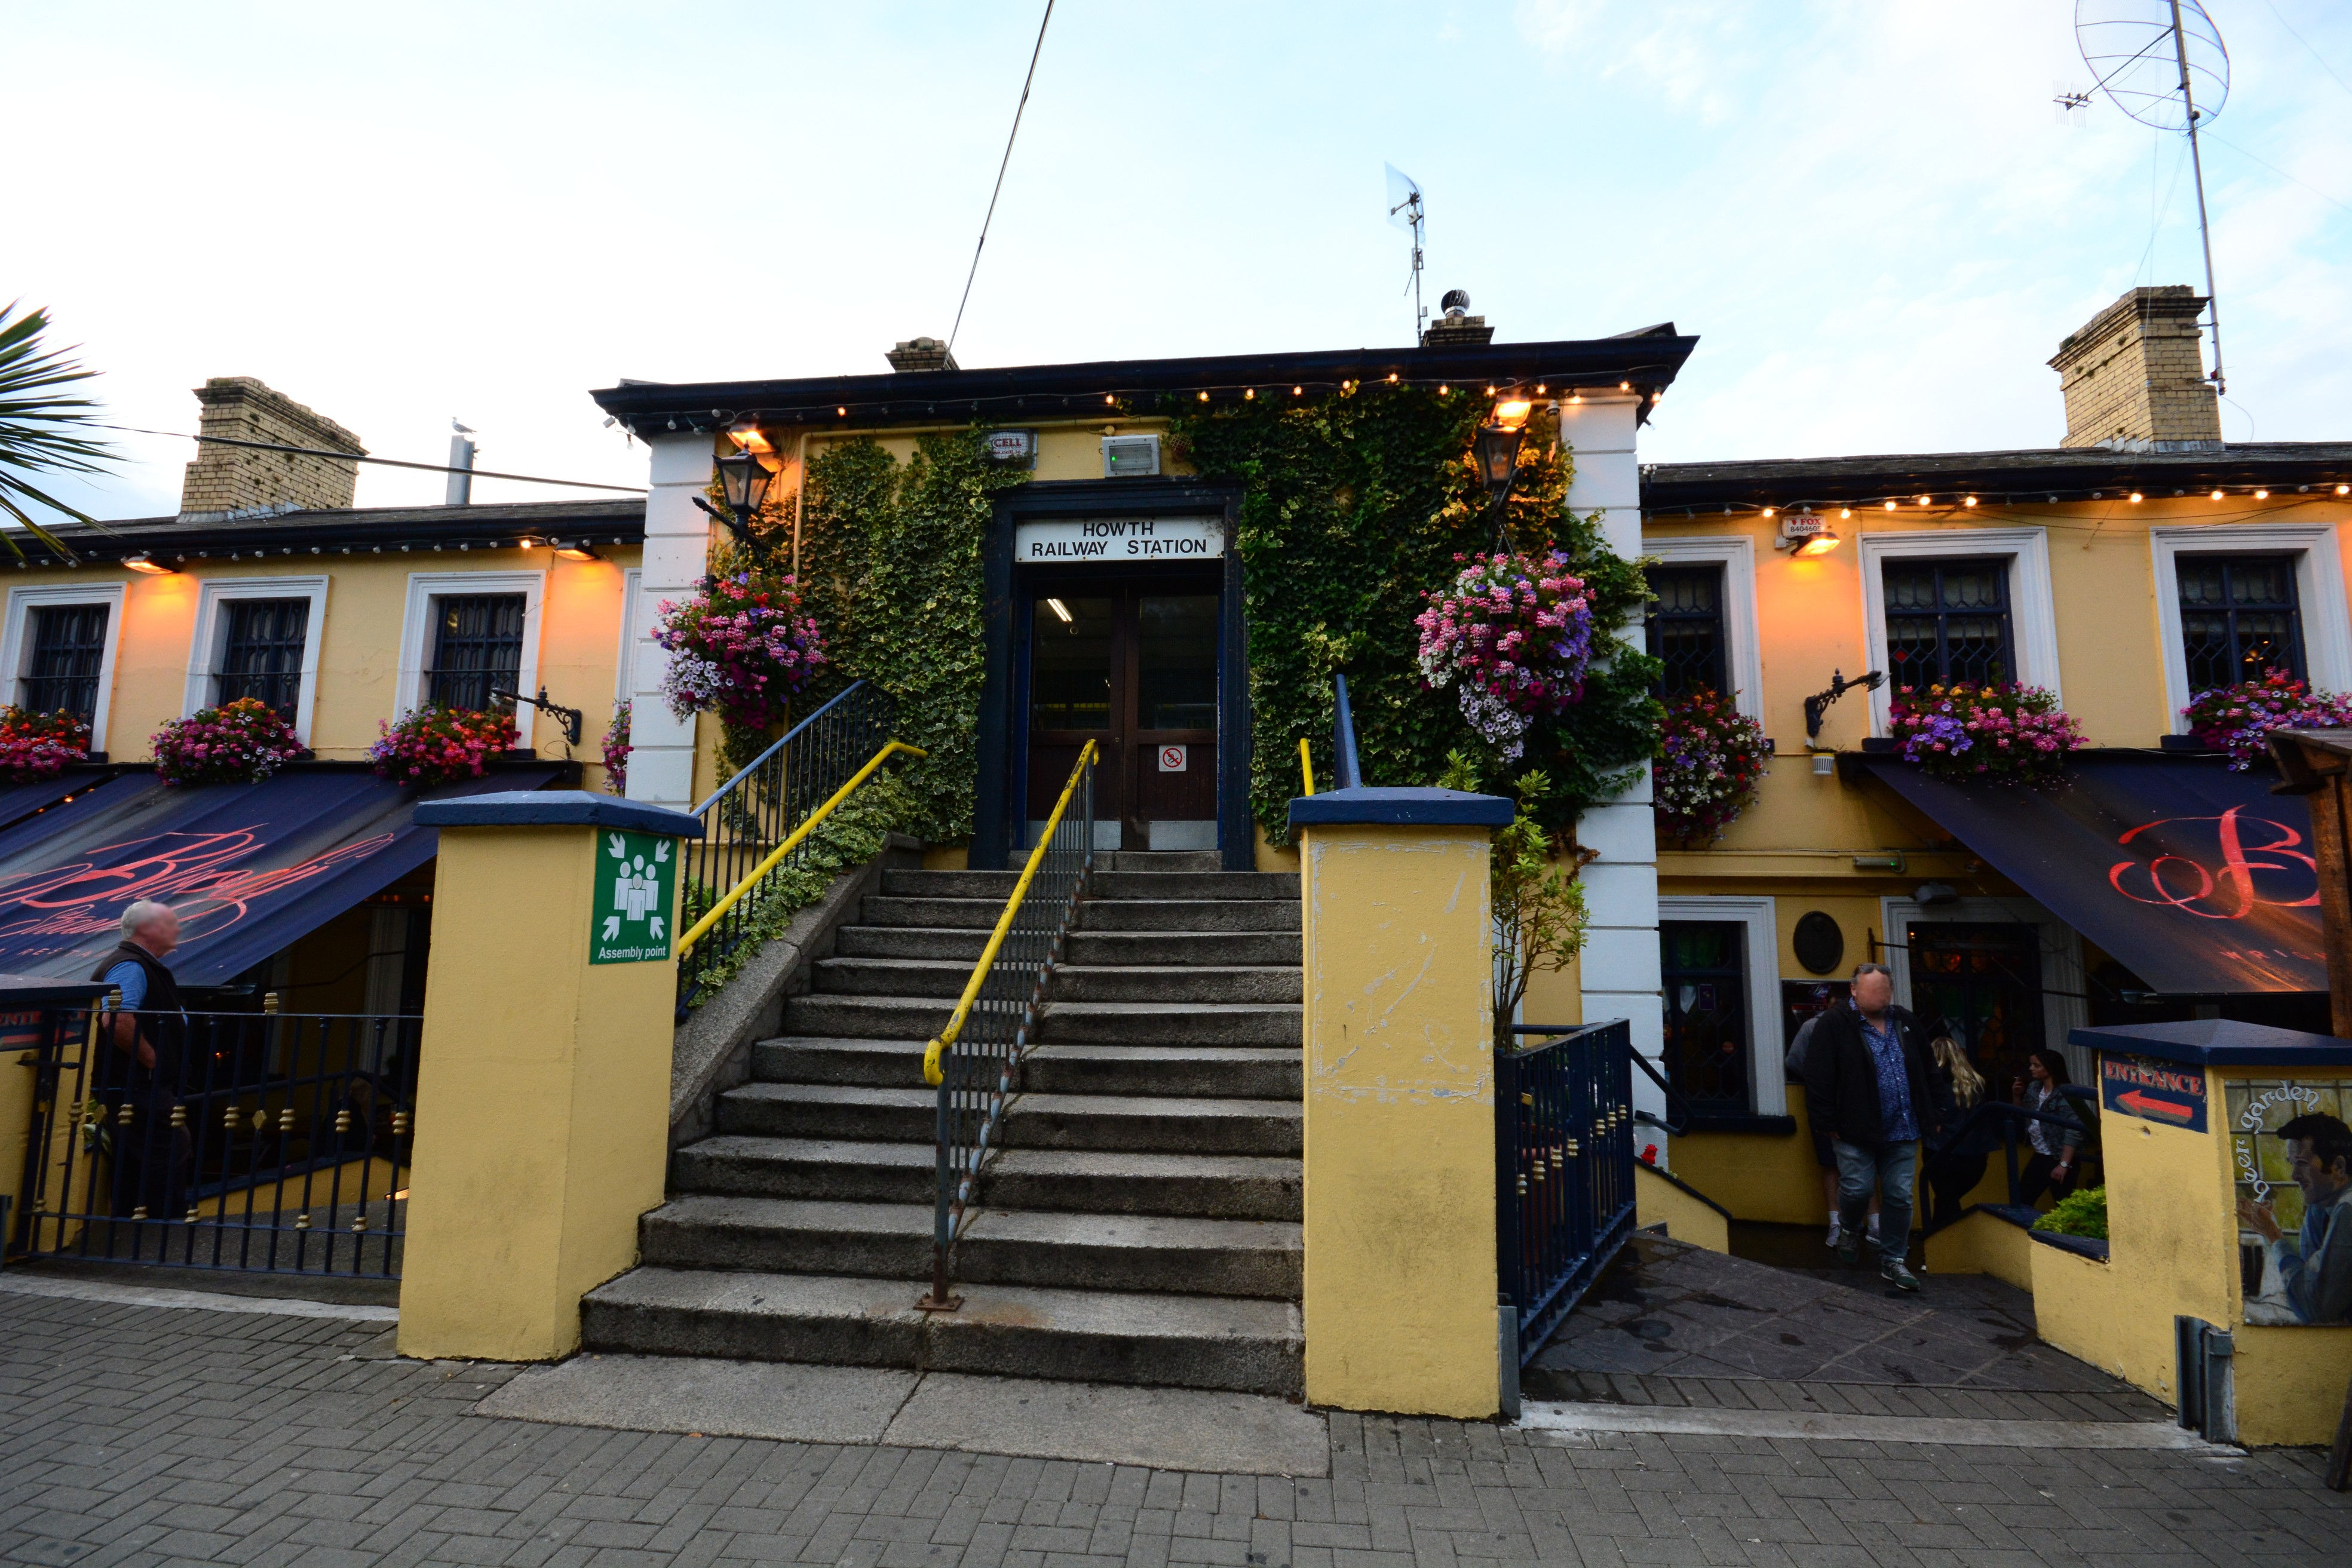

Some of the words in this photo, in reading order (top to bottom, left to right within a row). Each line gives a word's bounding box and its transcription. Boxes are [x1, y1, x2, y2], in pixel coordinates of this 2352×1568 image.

[993, 438, 1022, 448] CELL
[1083, 521, 1154, 537] HOWTH
[1032, 541, 1108, 556] RAILWAY
[1127, 539, 1206, 554] STATION
[598, 946, 643, 960] Assembly
[645, 946, 666, 959] point
[2105, 1060, 2204, 1096] ENTRANCE
[2241, 1080, 2320, 1135] garden
